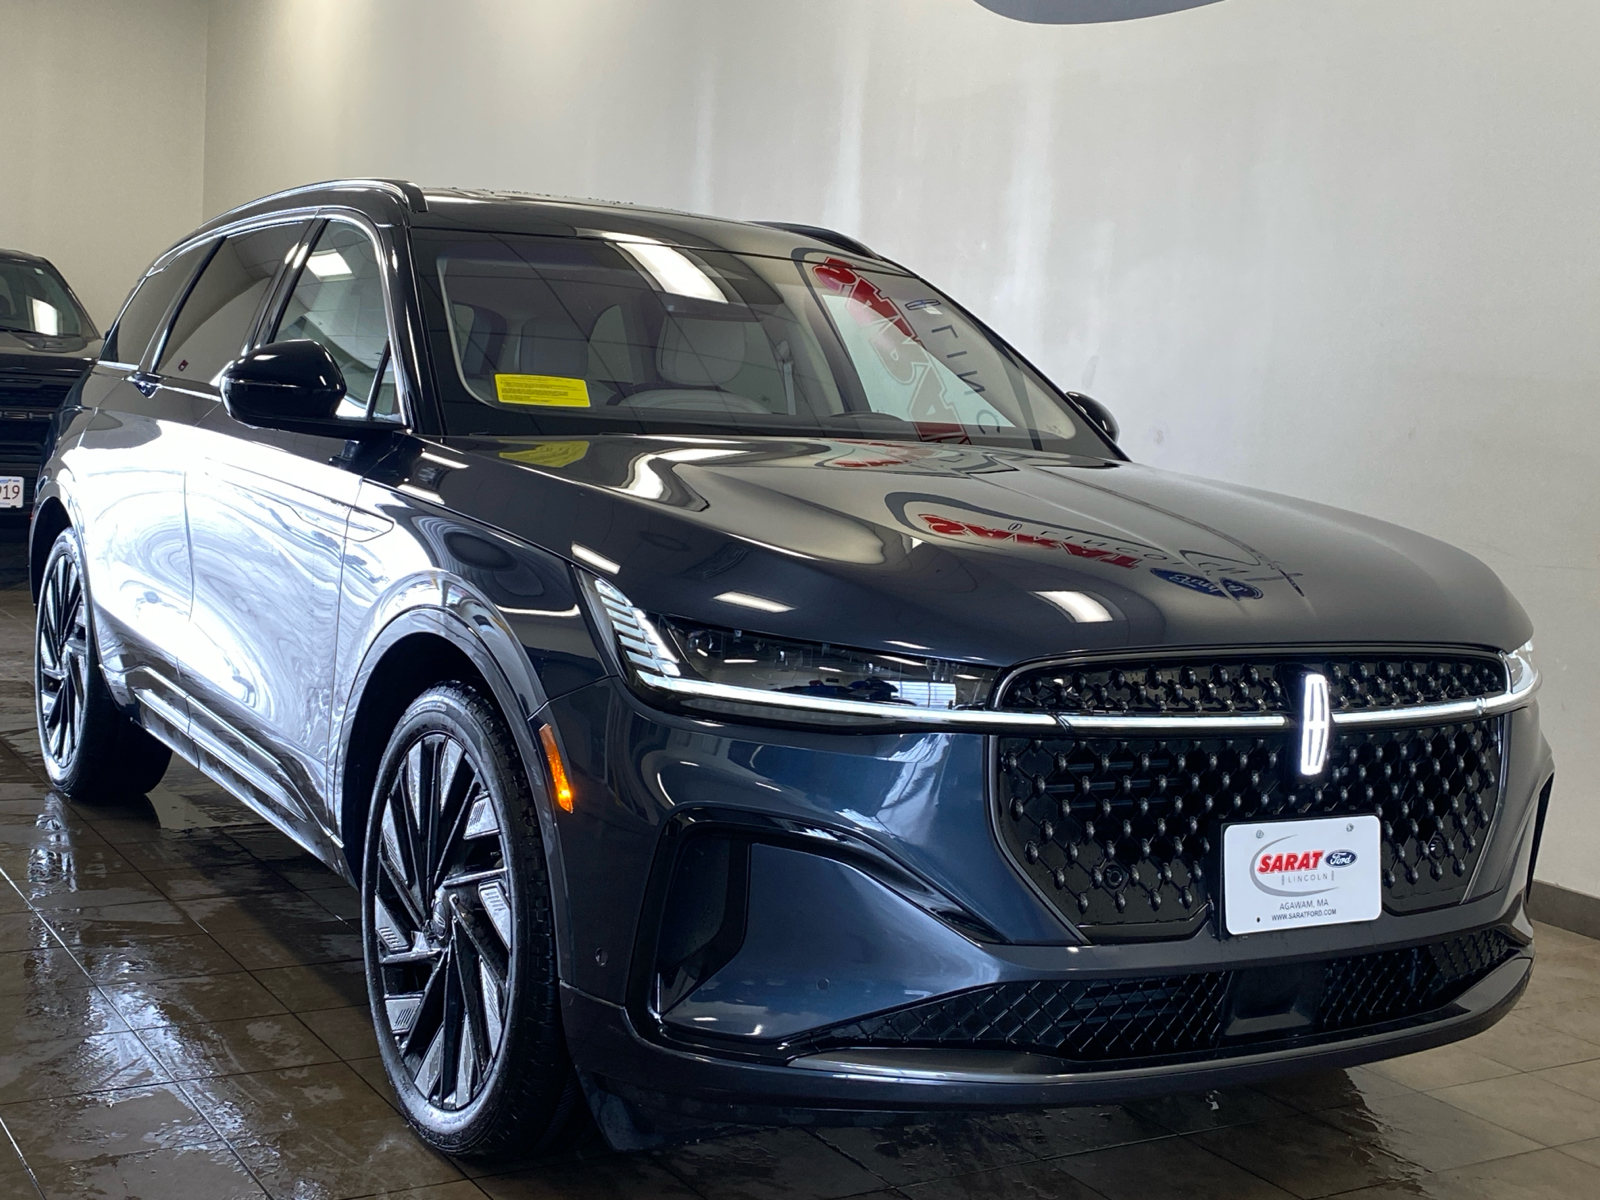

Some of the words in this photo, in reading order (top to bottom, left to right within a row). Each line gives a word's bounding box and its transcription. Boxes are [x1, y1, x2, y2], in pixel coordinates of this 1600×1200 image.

[1257, 850, 1325, 875] SARAT
[1330, 852, 1352, 865] Ford
[1287, 873, 1328, 883] LINCOLN
[1279, 901, 1315, 911] AGAWAM,
[1317, 899, 1329, 907] MA
[1271, 908, 1337, 921] WWW.SARATFORD.COM
